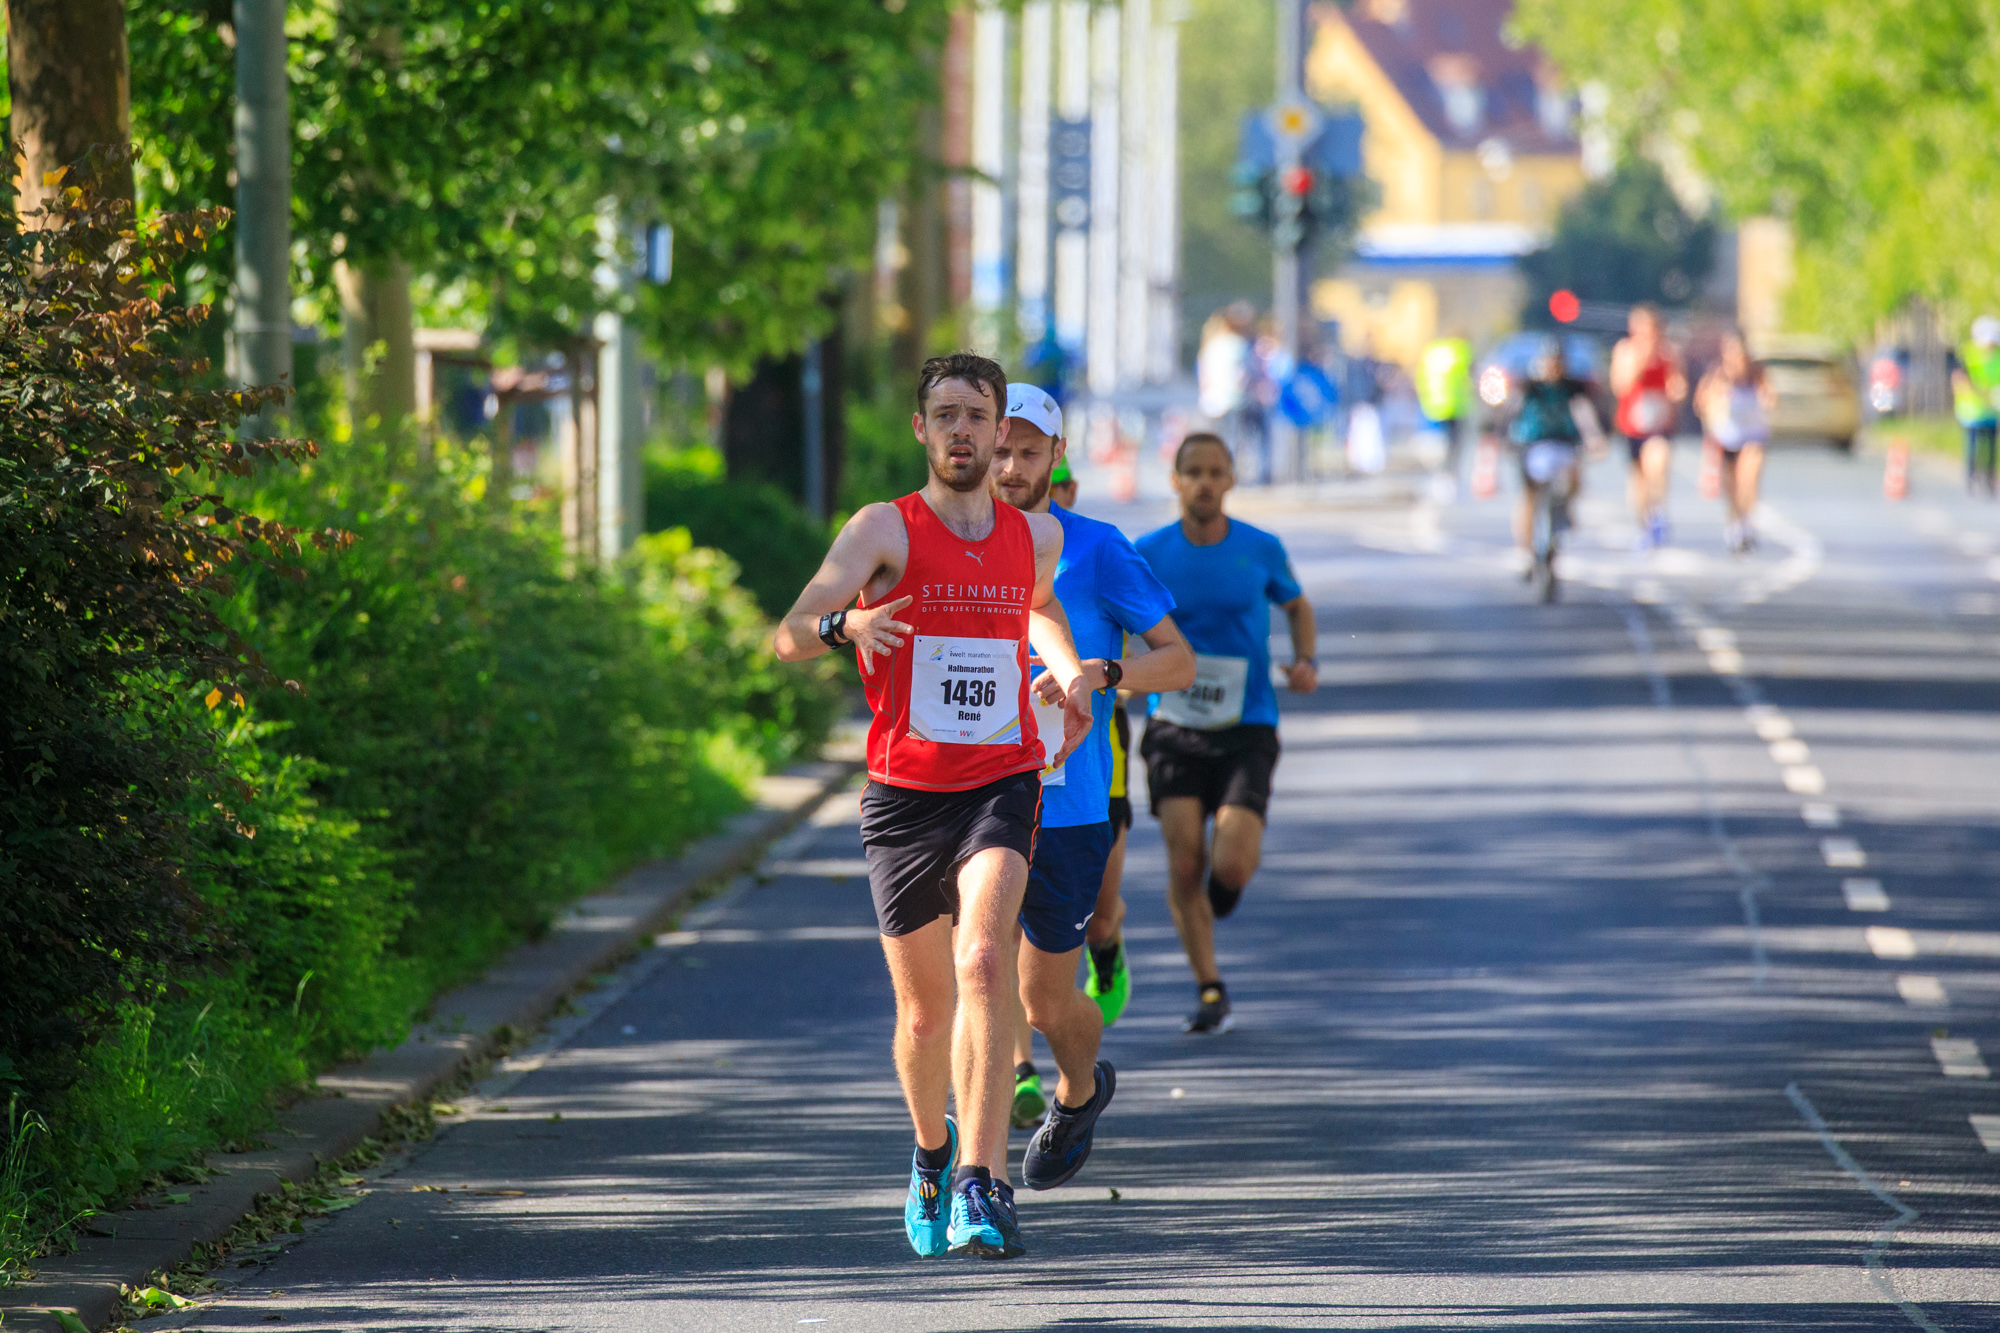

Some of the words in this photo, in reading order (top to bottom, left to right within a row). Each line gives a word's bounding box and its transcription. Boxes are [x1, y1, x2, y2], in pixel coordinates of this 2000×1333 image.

[922, 584, 1026, 601] STEINMETZ
[943, 606, 1022, 616] OBJEKTEINRICHTER
[968, 651, 991, 659] marathon
[947, 664, 995, 674] Halbmarathon
[940, 679, 997, 707] 1436
[958, 710, 982, 722] René
